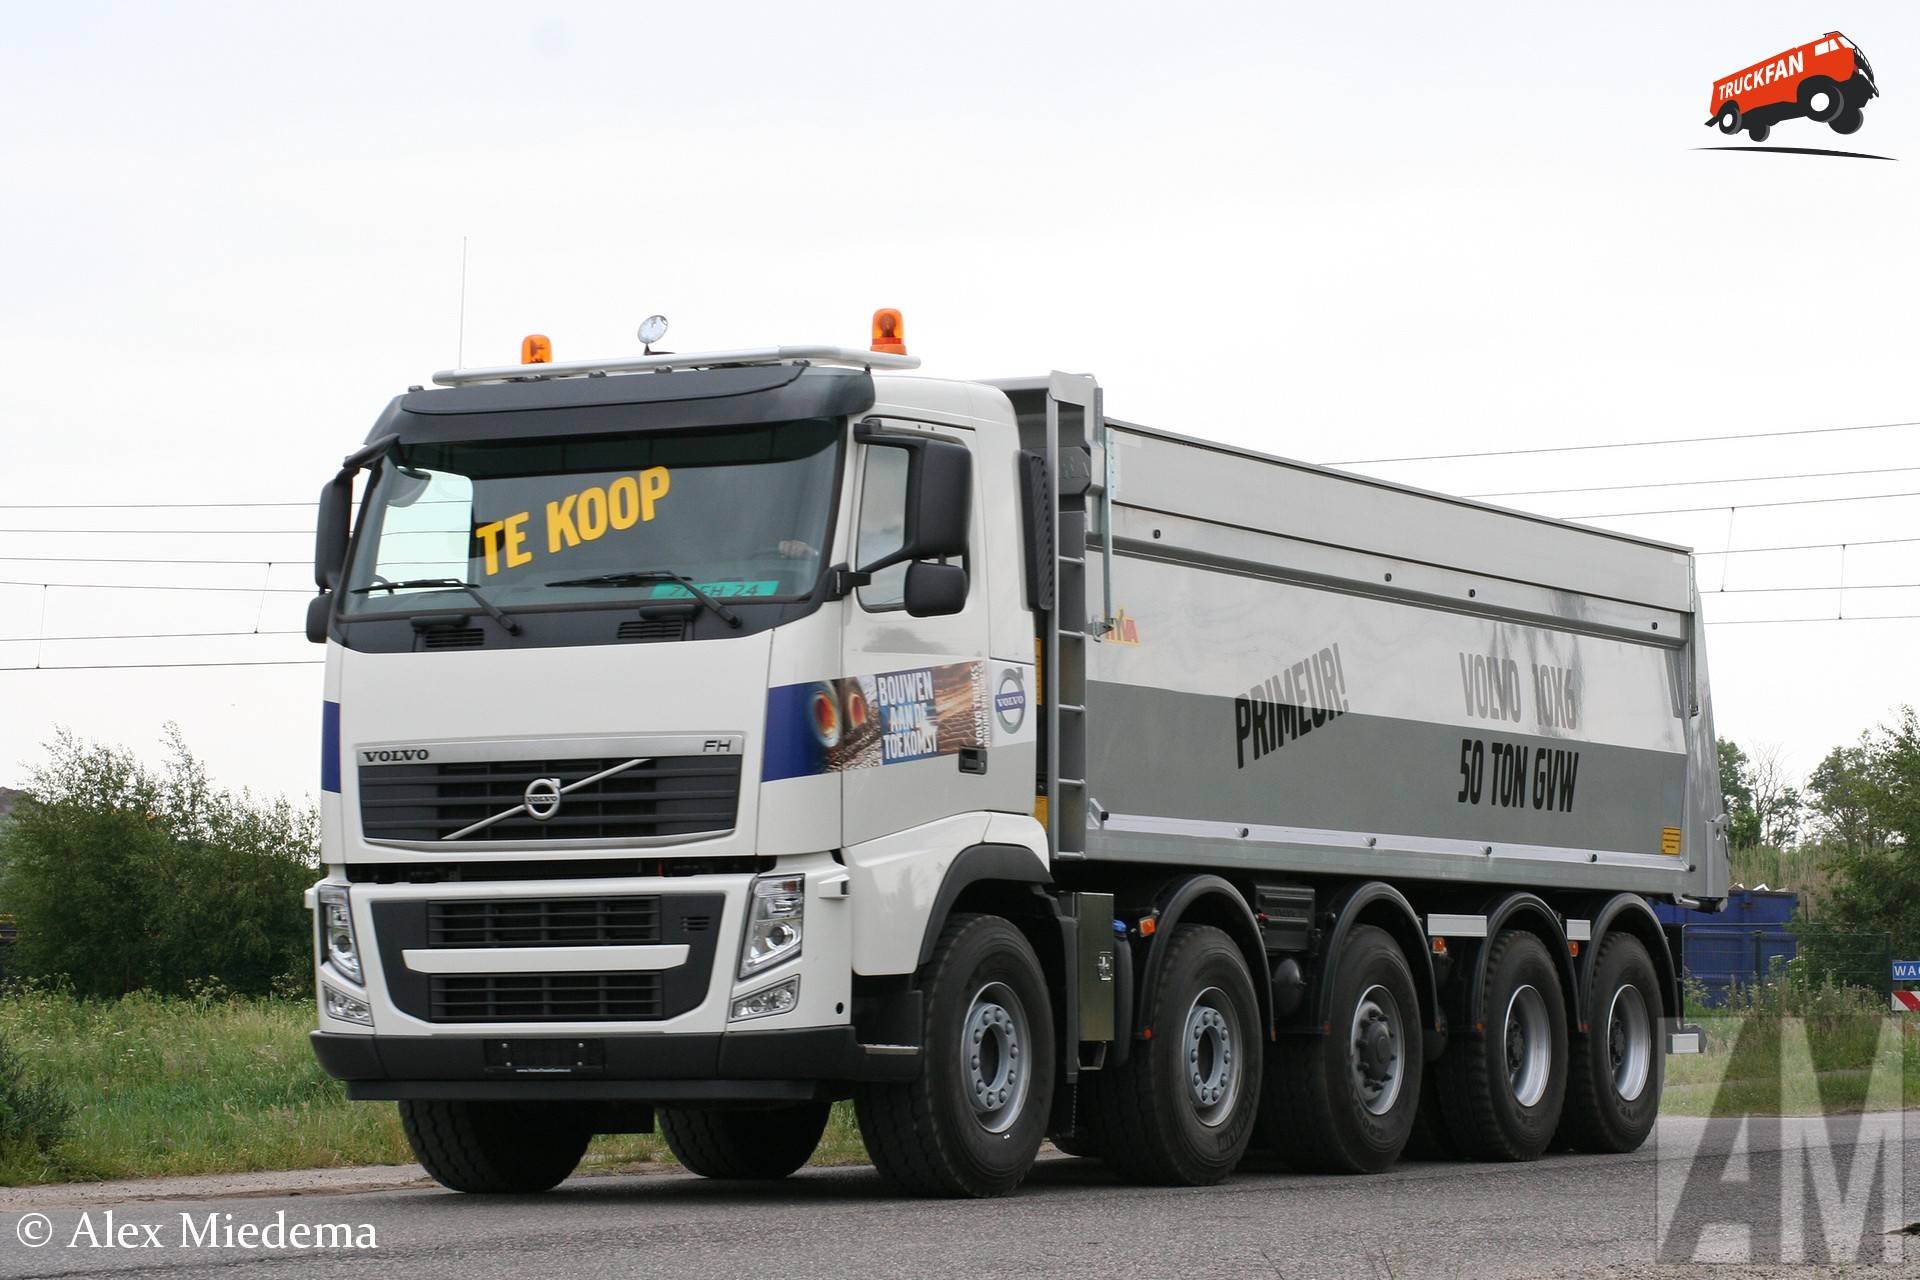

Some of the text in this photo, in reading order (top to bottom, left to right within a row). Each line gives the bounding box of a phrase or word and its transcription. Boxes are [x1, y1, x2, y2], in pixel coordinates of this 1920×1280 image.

[475, 465, 671, 576] TE KOOP
[877, 670, 934, 706] BOUWEN
[996, 695, 1025, 707] VOLVO
[1234, 641, 1350, 769] PRIMEUR!
[1458, 651, 1522, 724] VOLVO
[362, 748, 430, 763] VOLVO
[702, 739, 732, 753] FH
[882, 725, 938, 760] TOEKOMST
[1457, 738, 1580, 814] 50 TON GVW
[526, 794, 559, 803] VOLVO
[1893, 964, 1920, 977] WA
